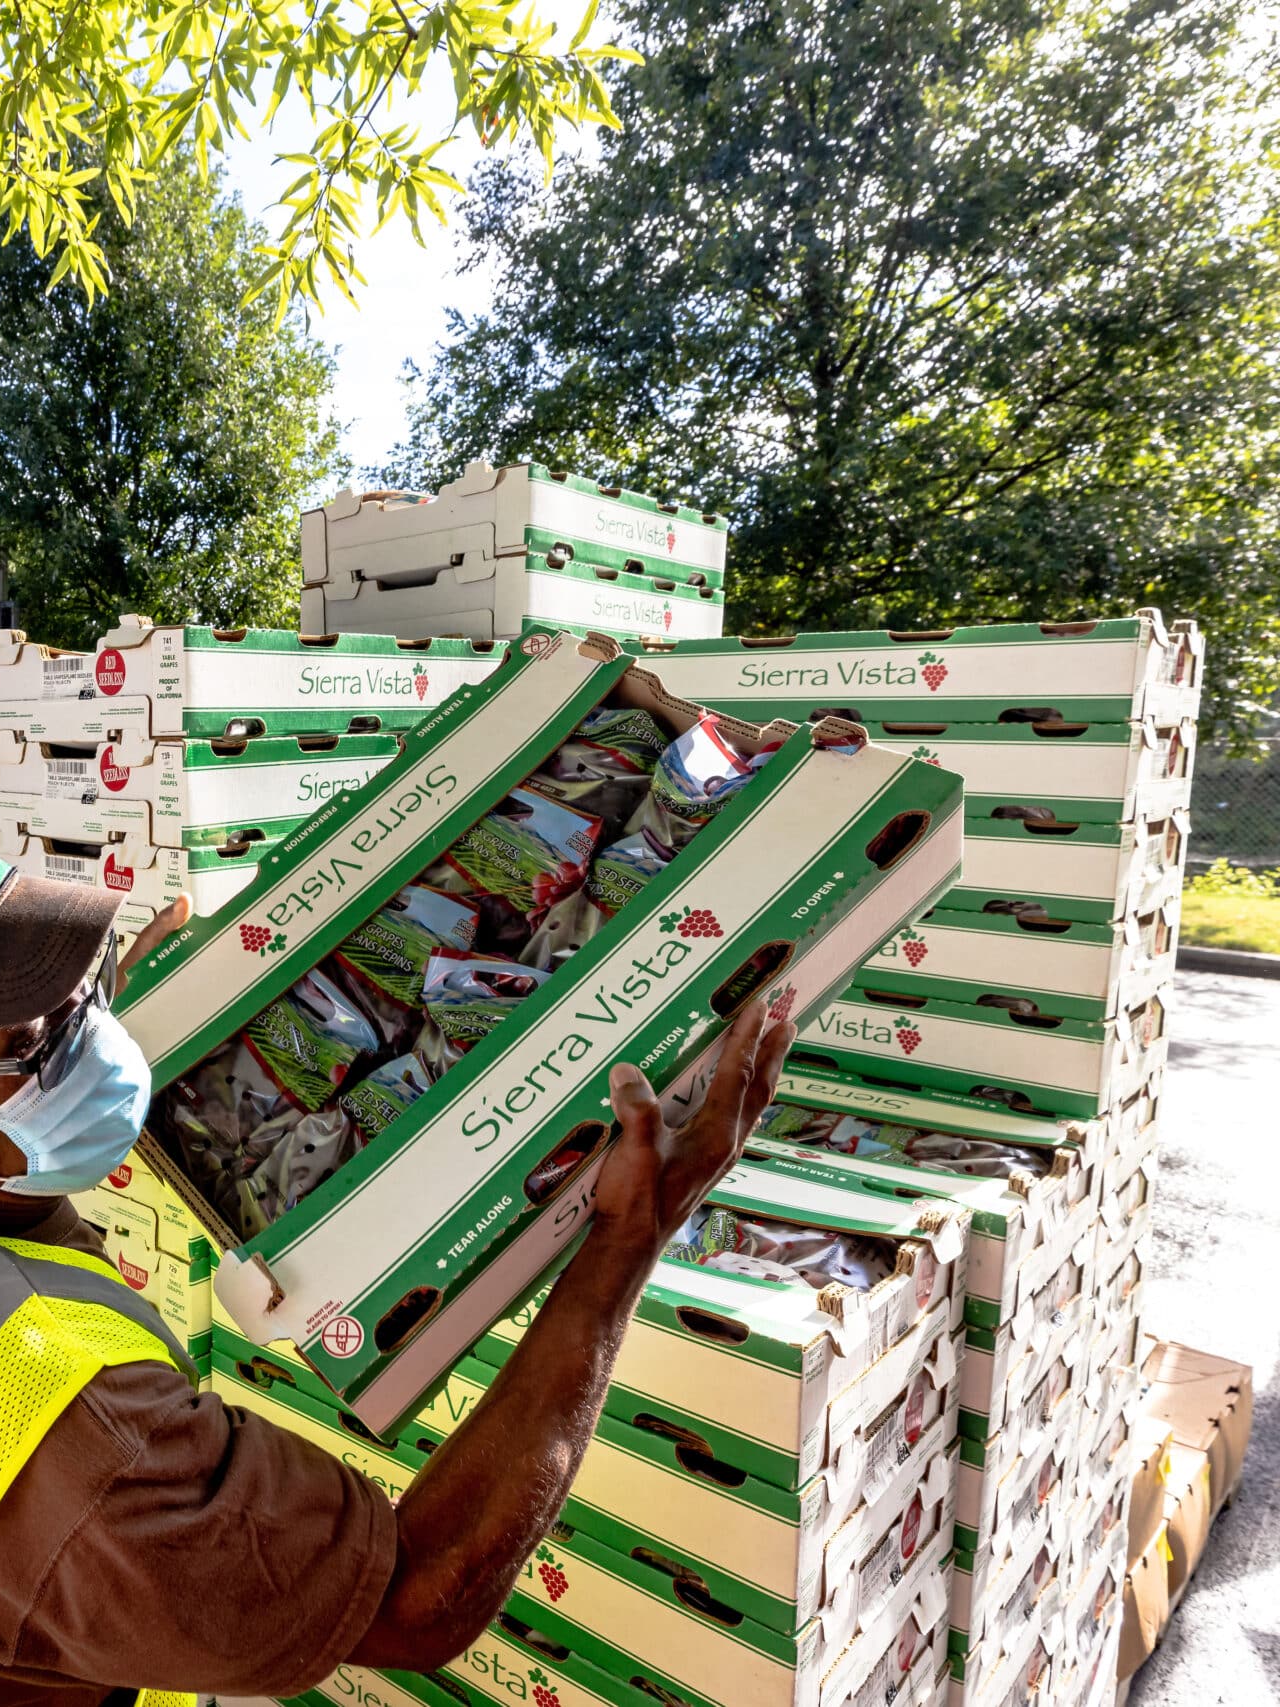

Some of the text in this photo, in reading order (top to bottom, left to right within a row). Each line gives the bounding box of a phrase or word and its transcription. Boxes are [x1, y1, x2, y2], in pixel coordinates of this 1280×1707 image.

[595, 511, 666, 547] Sierra Vista
[592, 593, 663, 626] Sierra Vista
[105, 656, 116, 669] RED
[738, 658, 917, 688] Sierra Vista
[99, 672, 124, 686] SEEDLESS
[298, 667, 413, 695] Sierra Vista
[416, 699, 464, 738] TEAR ALONG
[297, 773, 361, 801] Sierra
[284, 806, 338, 853] PERFORATION
[266, 764, 458, 927] Sierra Vista
[483, 833, 519, 860] GRAPES
[107, 872, 132, 889] SEEDLESS
[792, 881, 836, 920] TO OPEN
[156, 929, 193, 962] TO OPEN
[366, 924, 407, 950] GRAPES
[817, 1011, 892, 1044] Vista
[461, 1032, 597, 1153] Sierra
[575, 937, 693, 1030] Vista
[639, 1026, 686, 1070] ORATION
[806, 1083, 910, 1110] Sierra
[775, 1160, 809, 1175] ALONG
[809, 1168, 835, 1180] TEAR
[163, 1215, 188, 1229] CALIFORNIA
[165, 1203, 185, 1215] PRODUCT
[448, 1195, 513, 1259] TEAR ALONG
[121, 1262, 147, 1286] SEEDLESS
[164, 1309, 187, 1325] CALIFORNIA
[166, 1297, 185, 1311] PRODUCT
